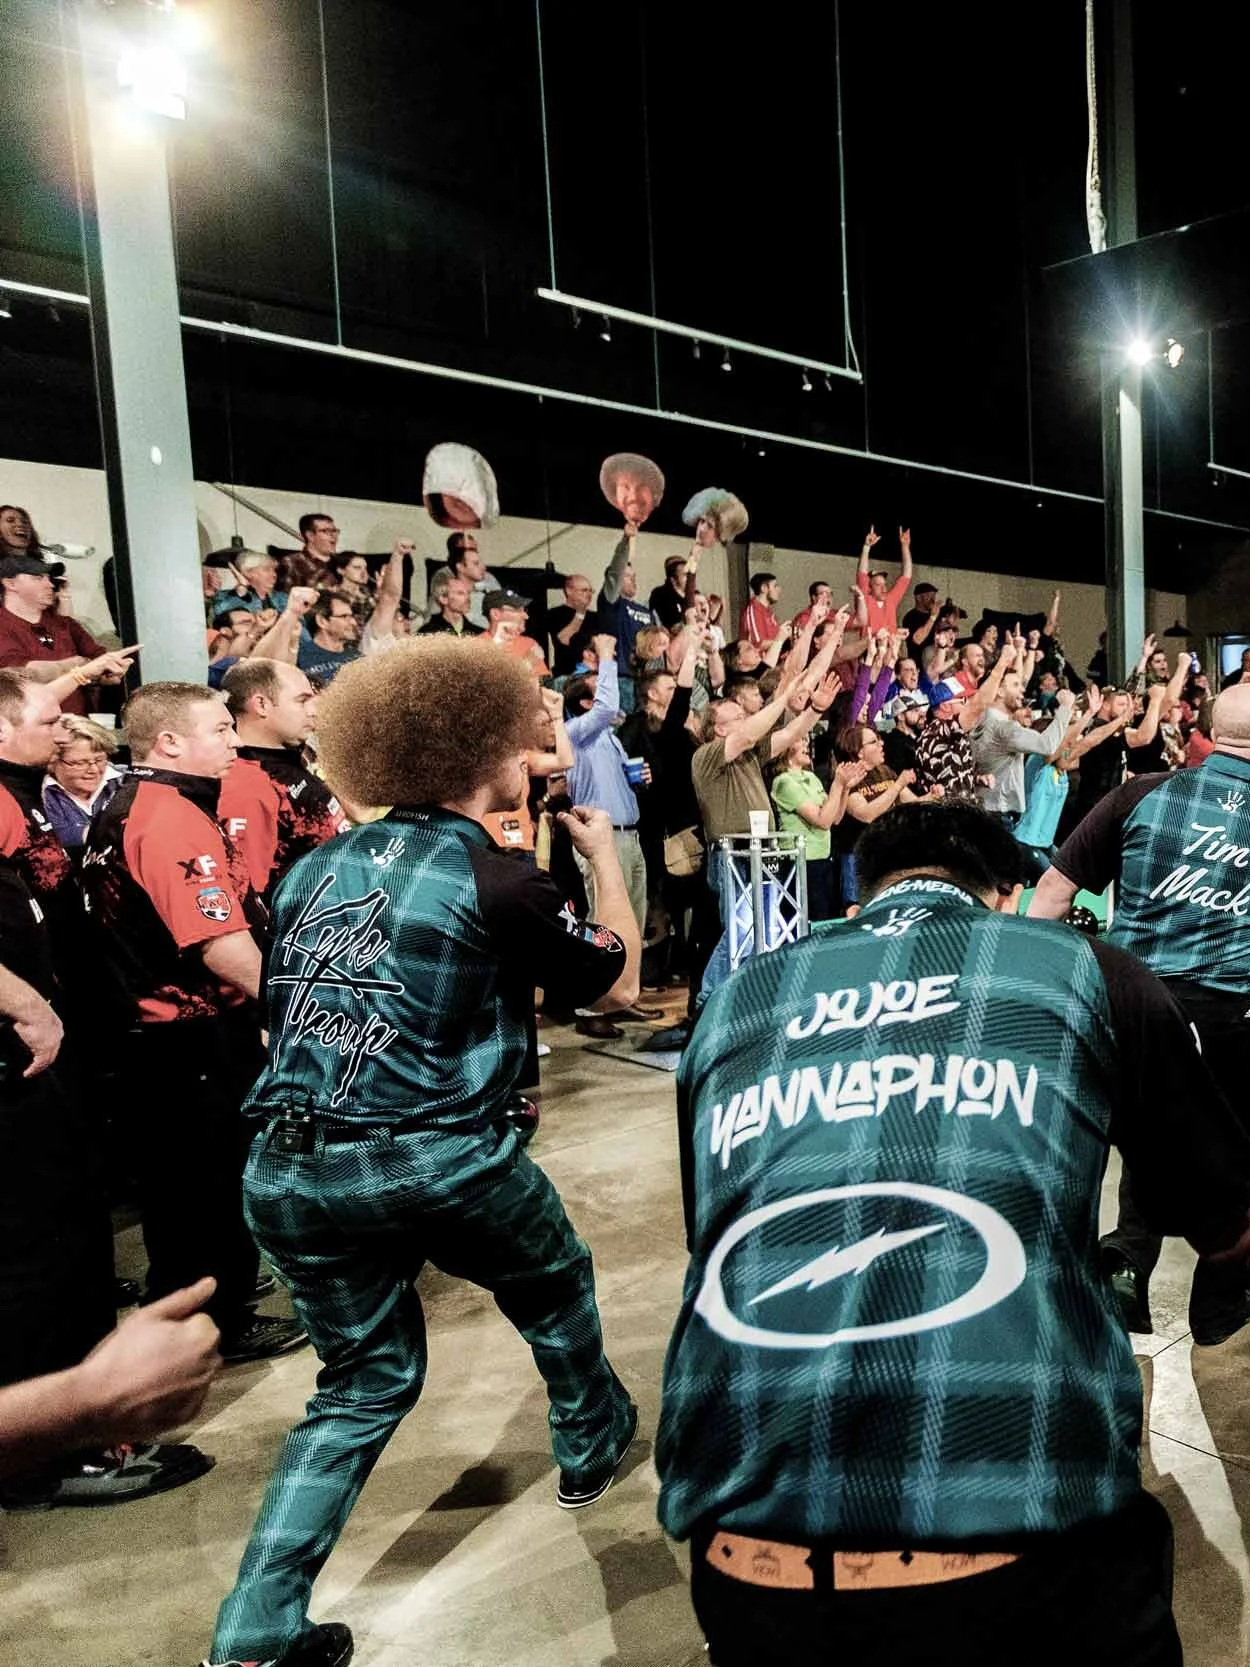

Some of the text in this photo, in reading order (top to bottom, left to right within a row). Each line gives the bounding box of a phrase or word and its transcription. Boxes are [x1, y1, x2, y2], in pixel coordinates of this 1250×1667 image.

[176, 855, 217, 880] XF
[1182, 823, 1250, 867] Tim
[282, 873, 391, 982] Kyle
[268, 950, 405, 1107] Troup
[786, 974, 961, 1039] JOJOE
[711, 1053, 1038, 1170] YANNAPHON
